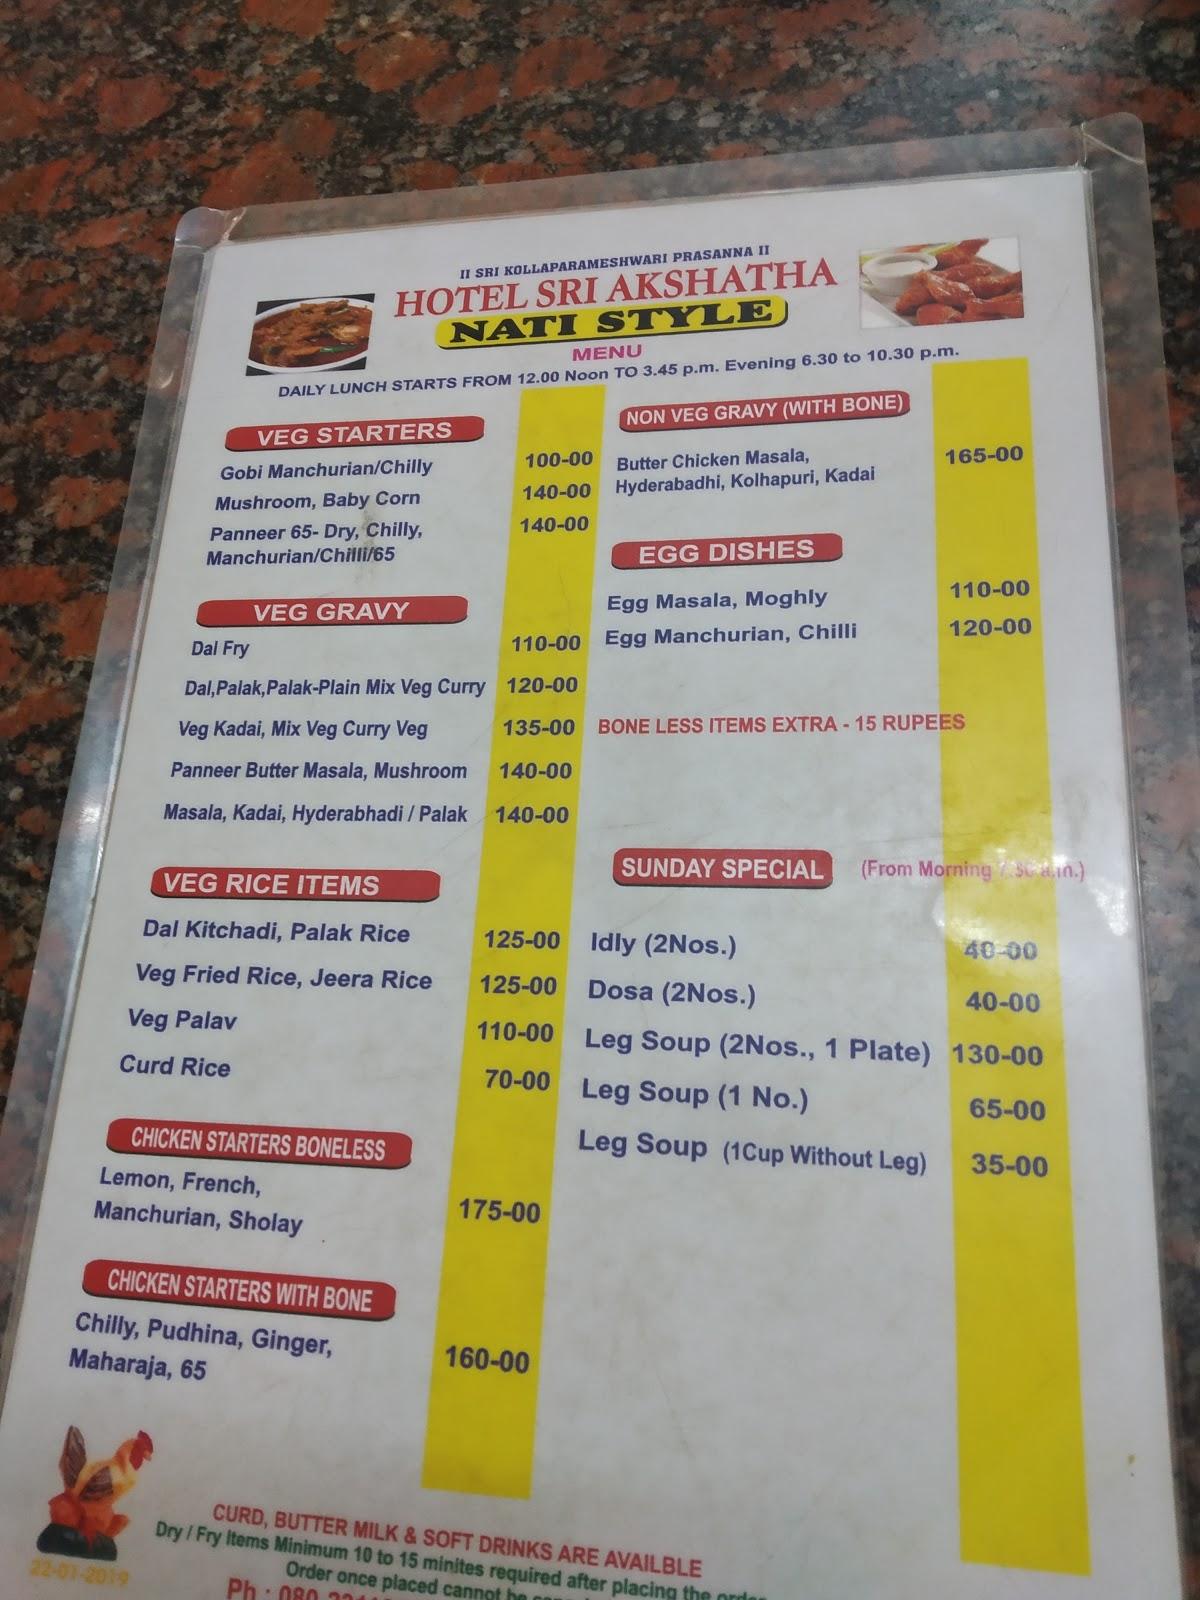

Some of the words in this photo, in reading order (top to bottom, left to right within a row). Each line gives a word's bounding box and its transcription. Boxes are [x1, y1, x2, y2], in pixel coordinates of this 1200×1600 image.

[475, 266, 500, 278] SRI
[504, 253, 668, 276] KOLLAPARAMESHWARI
[673, 247, 753, 262] PRASANNA
[394, 282, 529, 318] HOTEL
[535, 277, 597, 309] SRI
[607, 257, 838, 302] AKSHATHA
[449, 314, 577, 343] NATI
[596, 299, 773, 333] STYLE
[572, 344, 643, 362] MENU
[278, 384, 325, 398] DAILY
[330, 381, 387, 395] LUNCH
[391, 377, 457, 392] STARTS
[462, 373, 512, 388] FROM
[518, 372, 559, 385] 12.00
[565, 368, 608, 381] Noon
[614, 366, 638, 378] TO
[643, 364, 677, 377] 3.45
[683, 363, 720, 378] p.m.
[725, 355, 796, 372] Evening
[802, 353, 838, 367] 6.30
[843, 351, 861, 364] to
[867, 347, 914, 361] 10.30
[920, 346, 959, 361] p.m.
[626, 409, 666, 426] NON
[670, 407, 709, 423] VEG
[714, 403, 777, 421] GRAVY
[783, 399, 838, 420] (WITH
[842, 395, 904, 414] BONE)
[257, 429, 309, 447] VEG
[316, 422, 452, 443] STARTERS
[525, 451, 594, 468] 100-00
[616, 454, 668, 472] Butter
[673, 451, 740, 469] Chicken
[745, 449, 810, 467] Masala,
[945, 446, 1024, 465] 165-00
[220, 465, 263, 481] Gobi
[268, 459, 434, 479] Manchurian/Chilly
[615, 475, 726, 495] Hyderabadhi,
[730, 471, 820, 490] Kolhapuri,
[825, 466, 876, 483] Kadai
[215, 495, 317, 511] Mushroom,
[322, 492, 370, 509] Baby
[375, 490, 421, 506] Corn
[209, 525, 286, 542] Panneer
[291, 525, 319, 540] 65-
[323, 522, 360, 541] Dry,
[365, 522, 423, 540] Chilly,
[520, 517, 590, 533] 140-00
[205, 546, 395, 566] Manchurian/Chilli/65
[638, 545, 701, 565] EGG
[709, 540, 816, 562] DISHES
[949, 580, 1031, 599] 110-00
[253, 604, 308, 621] VEG
[316, 602, 410, 620] GRAVY
[607, 595, 650, 614] Egg
[655, 593, 738, 611] Masala,
[745, 589, 828, 608] Moghly
[191, 641, 218, 656] Dal
[222, 640, 250, 659] Fry
[511, 635, 581, 652] 110-00
[184, 679, 360, 697] Dal,Palak,Palak-Plain
[365, 680, 395, 695] Mix
[400, 679, 433, 698] Veg
[438, 679, 486, 697] Curry
[507, 677, 579, 693] 120-00
[598, 718, 650, 735] BONE
[656, 718, 703, 734] LESS
[708, 717, 767, 733] ITEMS
[772, 716, 838, 733] EXTRA
[855, 715, 878, 732] 15
[882, 714, 966, 732] RUPEES
[170, 762, 241, 779] Panneer
[246, 762, 298, 779] Butter
[303, 763, 369, 782] Masala,
[374, 762, 468, 780] Mushroom
[500, 762, 573, 780] 140-00
[163, 804, 227, 822] Masala,
[232, 804, 287, 823] Kadai,
[292, 804, 404, 825] Hyderabhadi
[419, 806, 468, 822] Palak
[621, 858, 716, 880] SUNDAY
[721, 859, 825, 880] SPECIAL
[861, 860, 912, 880] (From
[920, 860, 992, 882] Morning
[163, 873, 218, 894] VEG
[224, 874, 289, 894] RICE
[296, 875, 380, 896] ITEMS
[142, 919, 178, 937] Dal
[185, 920, 284, 942] Kitchadi,
[289, 922, 353, 942] Palak
[360, 924, 411, 943] Rice
[484, 930, 561, 950] 125-00
[590, 932, 636, 957] Idly
[644, 933, 737, 959] (2Nos.)
[128, 1008, 169, 1032] Veg
[174, 1010, 238, 1030] Palav
[477, 1022, 555, 1043] 110-00
[584, 1028, 634, 1054] Leg
[641, 1031, 711, 1057] Soup
[719, 1032, 816, 1059] (2Nos.,
[824, 1038, 839, 1058] 1
[848, 1038, 932, 1067] Plate)
[952, 1044, 1043, 1066] 130-00
[119, 1055, 174, 1076] Curd
[181, 1057, 231, 1077] Rice
[485, 1069, 552, 1090] 70-00
[131, 1126, 202, 1150] CHICKEN
[206, 1130, 292, 1155] STARTERS
[295, 1135, 386, 1161] BONELESS
[578, 1130, 628, 1157] Leg
[636, 1132, 708, 1158] Soup
[722, 1141, 785, 1167] (1Cup
[791, 1145, 873, 1170] Without
[878, 1149, 927, 1176] Leg)
[971, 1153, 1048, 1178] 35-00
[99, 1166, 176, 1190] Lemon,
[181, 1172, 262, 1197] French,
[93, 1201, 222, 1231] Manchurian,
[228, 1209, 304, 1238] Sholay
[459, 1198, 541, 1223] 175-00
[107, 1269, 180, 1295] CHICKEN
[184, 1275, 272, 1304] STARTERS
[276, 1283, 320, 1309] WITH
[323, 1287, 373, 1312] BONE
[74, 1312, 141, 1340] Chilly,
[146, 1319, 244, 1348] Pudhina,
[251, 1328, 334, 1358] Ginger,
[68, 1348, 173, 1380] Maharaja,
[180, 1359, 207, 1380] 65
[445, 1345, 530, 1373] 160-00
[212, 1503, 268, 1529] CURD,
[274, 1511, 348, 1536] BUTTER
[354, 1524, 400, 1542] MILK
[404, 1527, 417, 1544] &
[423, 1530, 474, 1551] SOFT
[480, 1535, 553, 1561] DRINKS
[557, 1544, 600, 1566] ARE
[604, 1551, 703, 1578] AVAILBLE
[156, 1521, 182, 1544] Dry
[196, 1524, 222, 1548] Fry
[226, 1530, 269, 1550] Items
[274, 1536, 348, 1560] Minimum
[354, 1546, 372, 1563] 10
[377, 1550, 394, 1565] to
[400, 1551, 418, 1568] 15
[423, 1555, 484, 1577] minites
[490, 1564, 562, 1587] required
[567, 1572, 607, 1591] after
